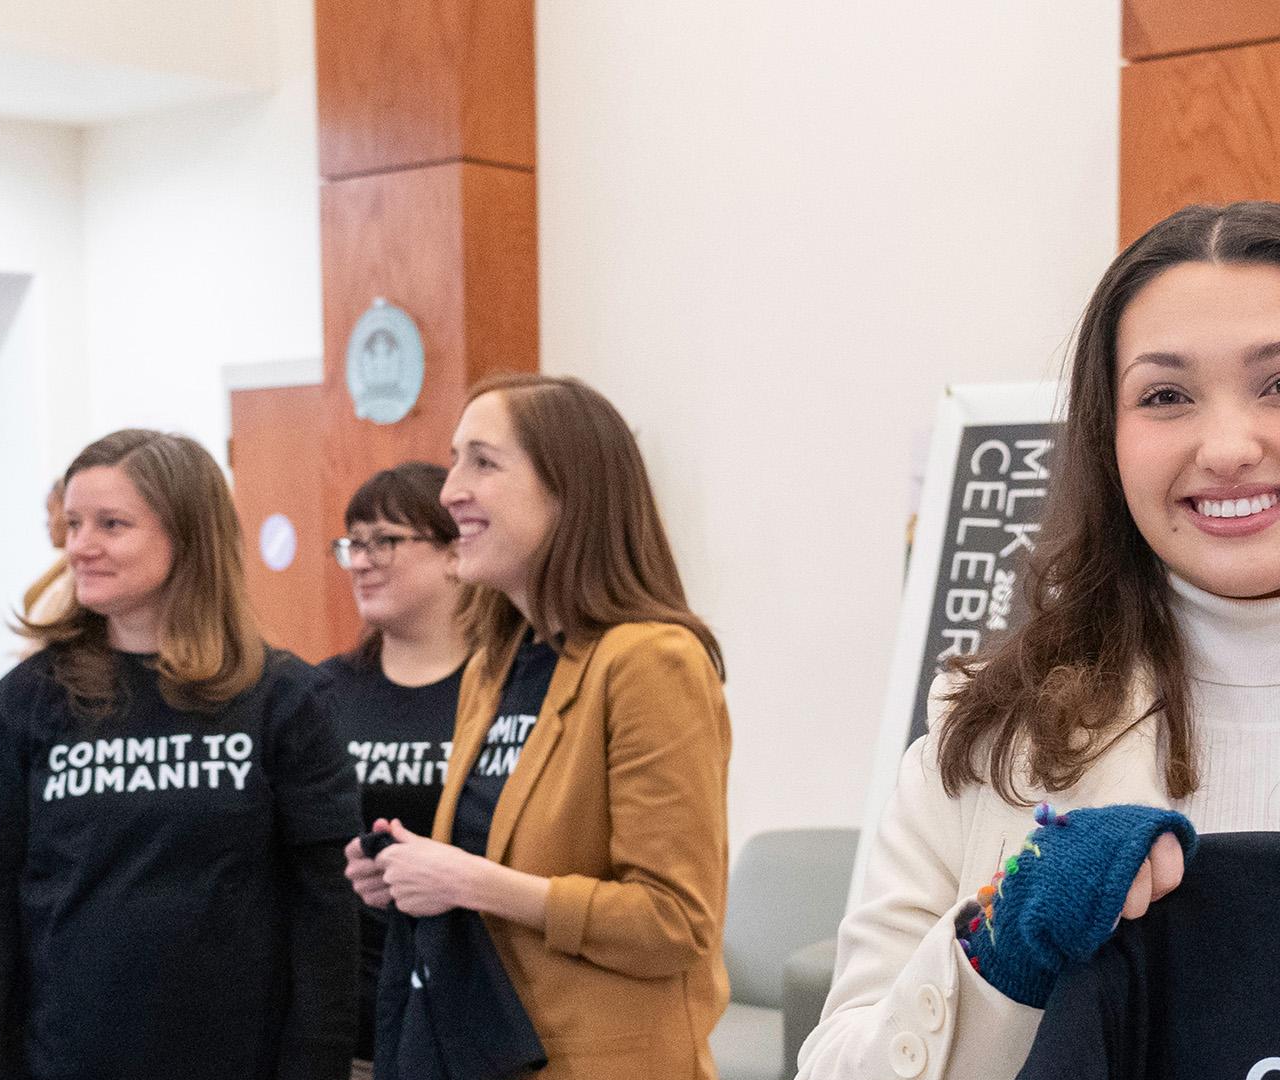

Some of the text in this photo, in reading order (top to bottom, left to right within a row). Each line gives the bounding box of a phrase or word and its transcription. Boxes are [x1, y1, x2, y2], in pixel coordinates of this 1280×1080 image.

[999, 439, 1054, 558] MLK
[936, 439, 1011, 664] CELEBR
[43, 761, 253, 801] HUMANITY
[48, 732, 253, 772] COMMIT TO
